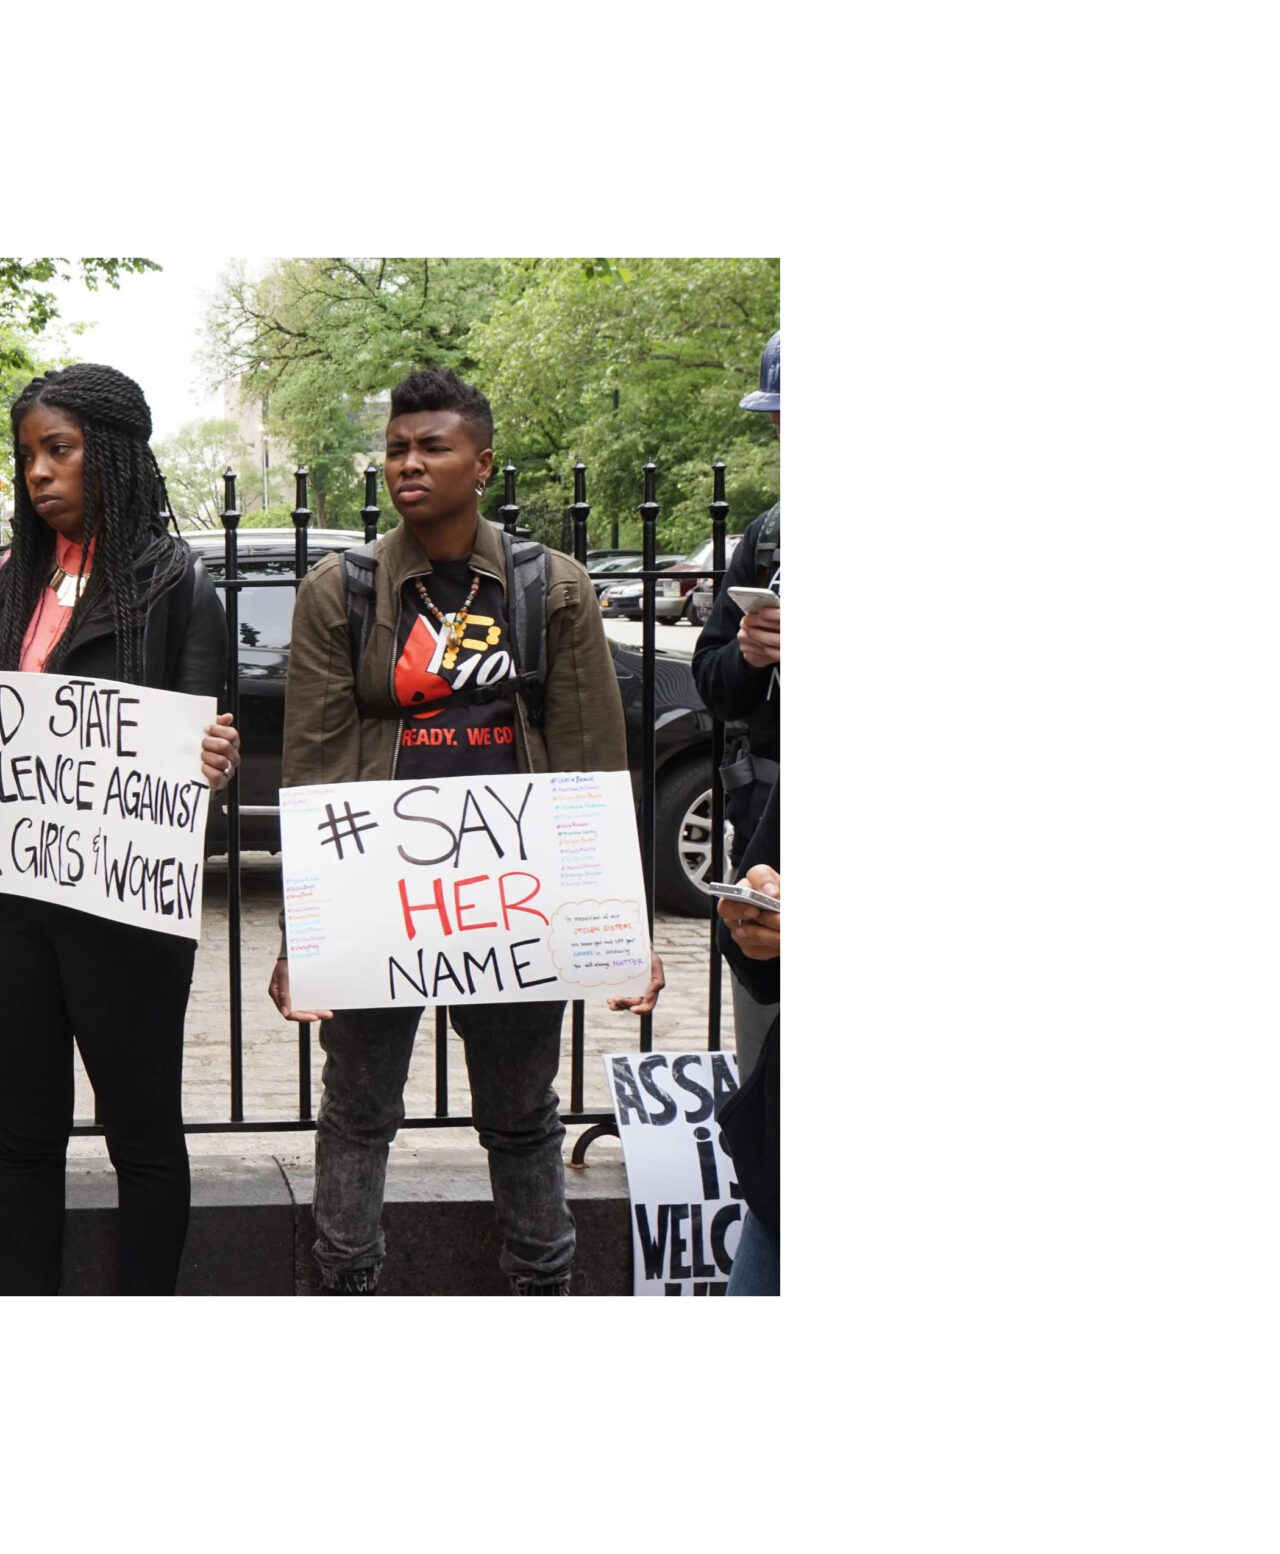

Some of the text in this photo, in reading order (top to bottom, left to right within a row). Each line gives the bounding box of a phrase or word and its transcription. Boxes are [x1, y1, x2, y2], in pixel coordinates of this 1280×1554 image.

[49, 680, 140, 757] STATE
[466, 727, 491, 746] WE
[104, 766, 209, 833] AGAINST
[318, 782, 534, 868] # SAY
[11, 817, 84, 886] GIRLS
[93, 827, 101, 875] &
[103, 835, 198, 919] WOMEN
[398, 871, 549, 940] HER
[389, 938, 558, 1000] NAME
